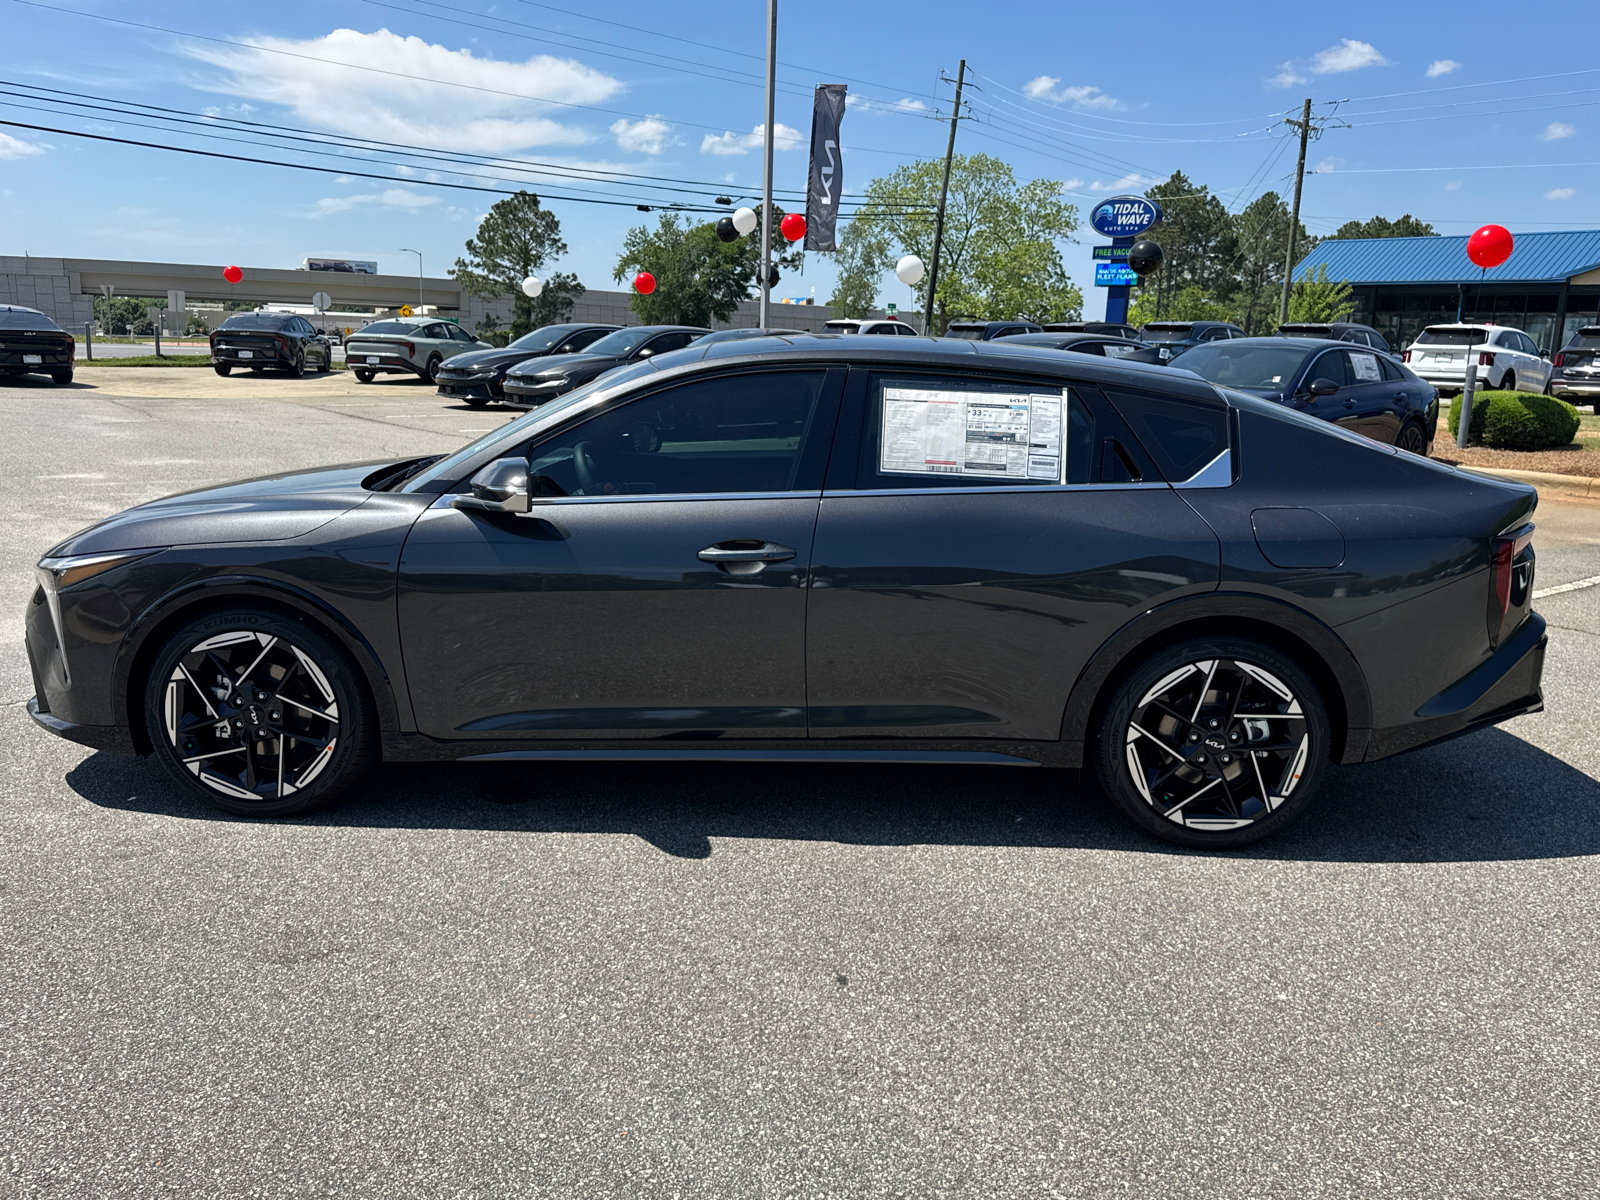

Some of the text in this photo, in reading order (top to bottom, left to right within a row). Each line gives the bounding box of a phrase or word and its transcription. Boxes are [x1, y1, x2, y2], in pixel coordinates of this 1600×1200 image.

[820, 139, 836, 205] KIA
[1114, 203, 1144, 214] TIDAL
[1117, 214, 1150, 225] WAVE
[1095, 248, 1131, 256] FREE VACU
[972, 409, 982, 417] 33
[204, 616, 259, 630] KUMHO
[1257, 652, 1275, 664] R18
[1205, 739, 1225, 750] KIA
[1245, 805, 1296, 839] KUMHO
